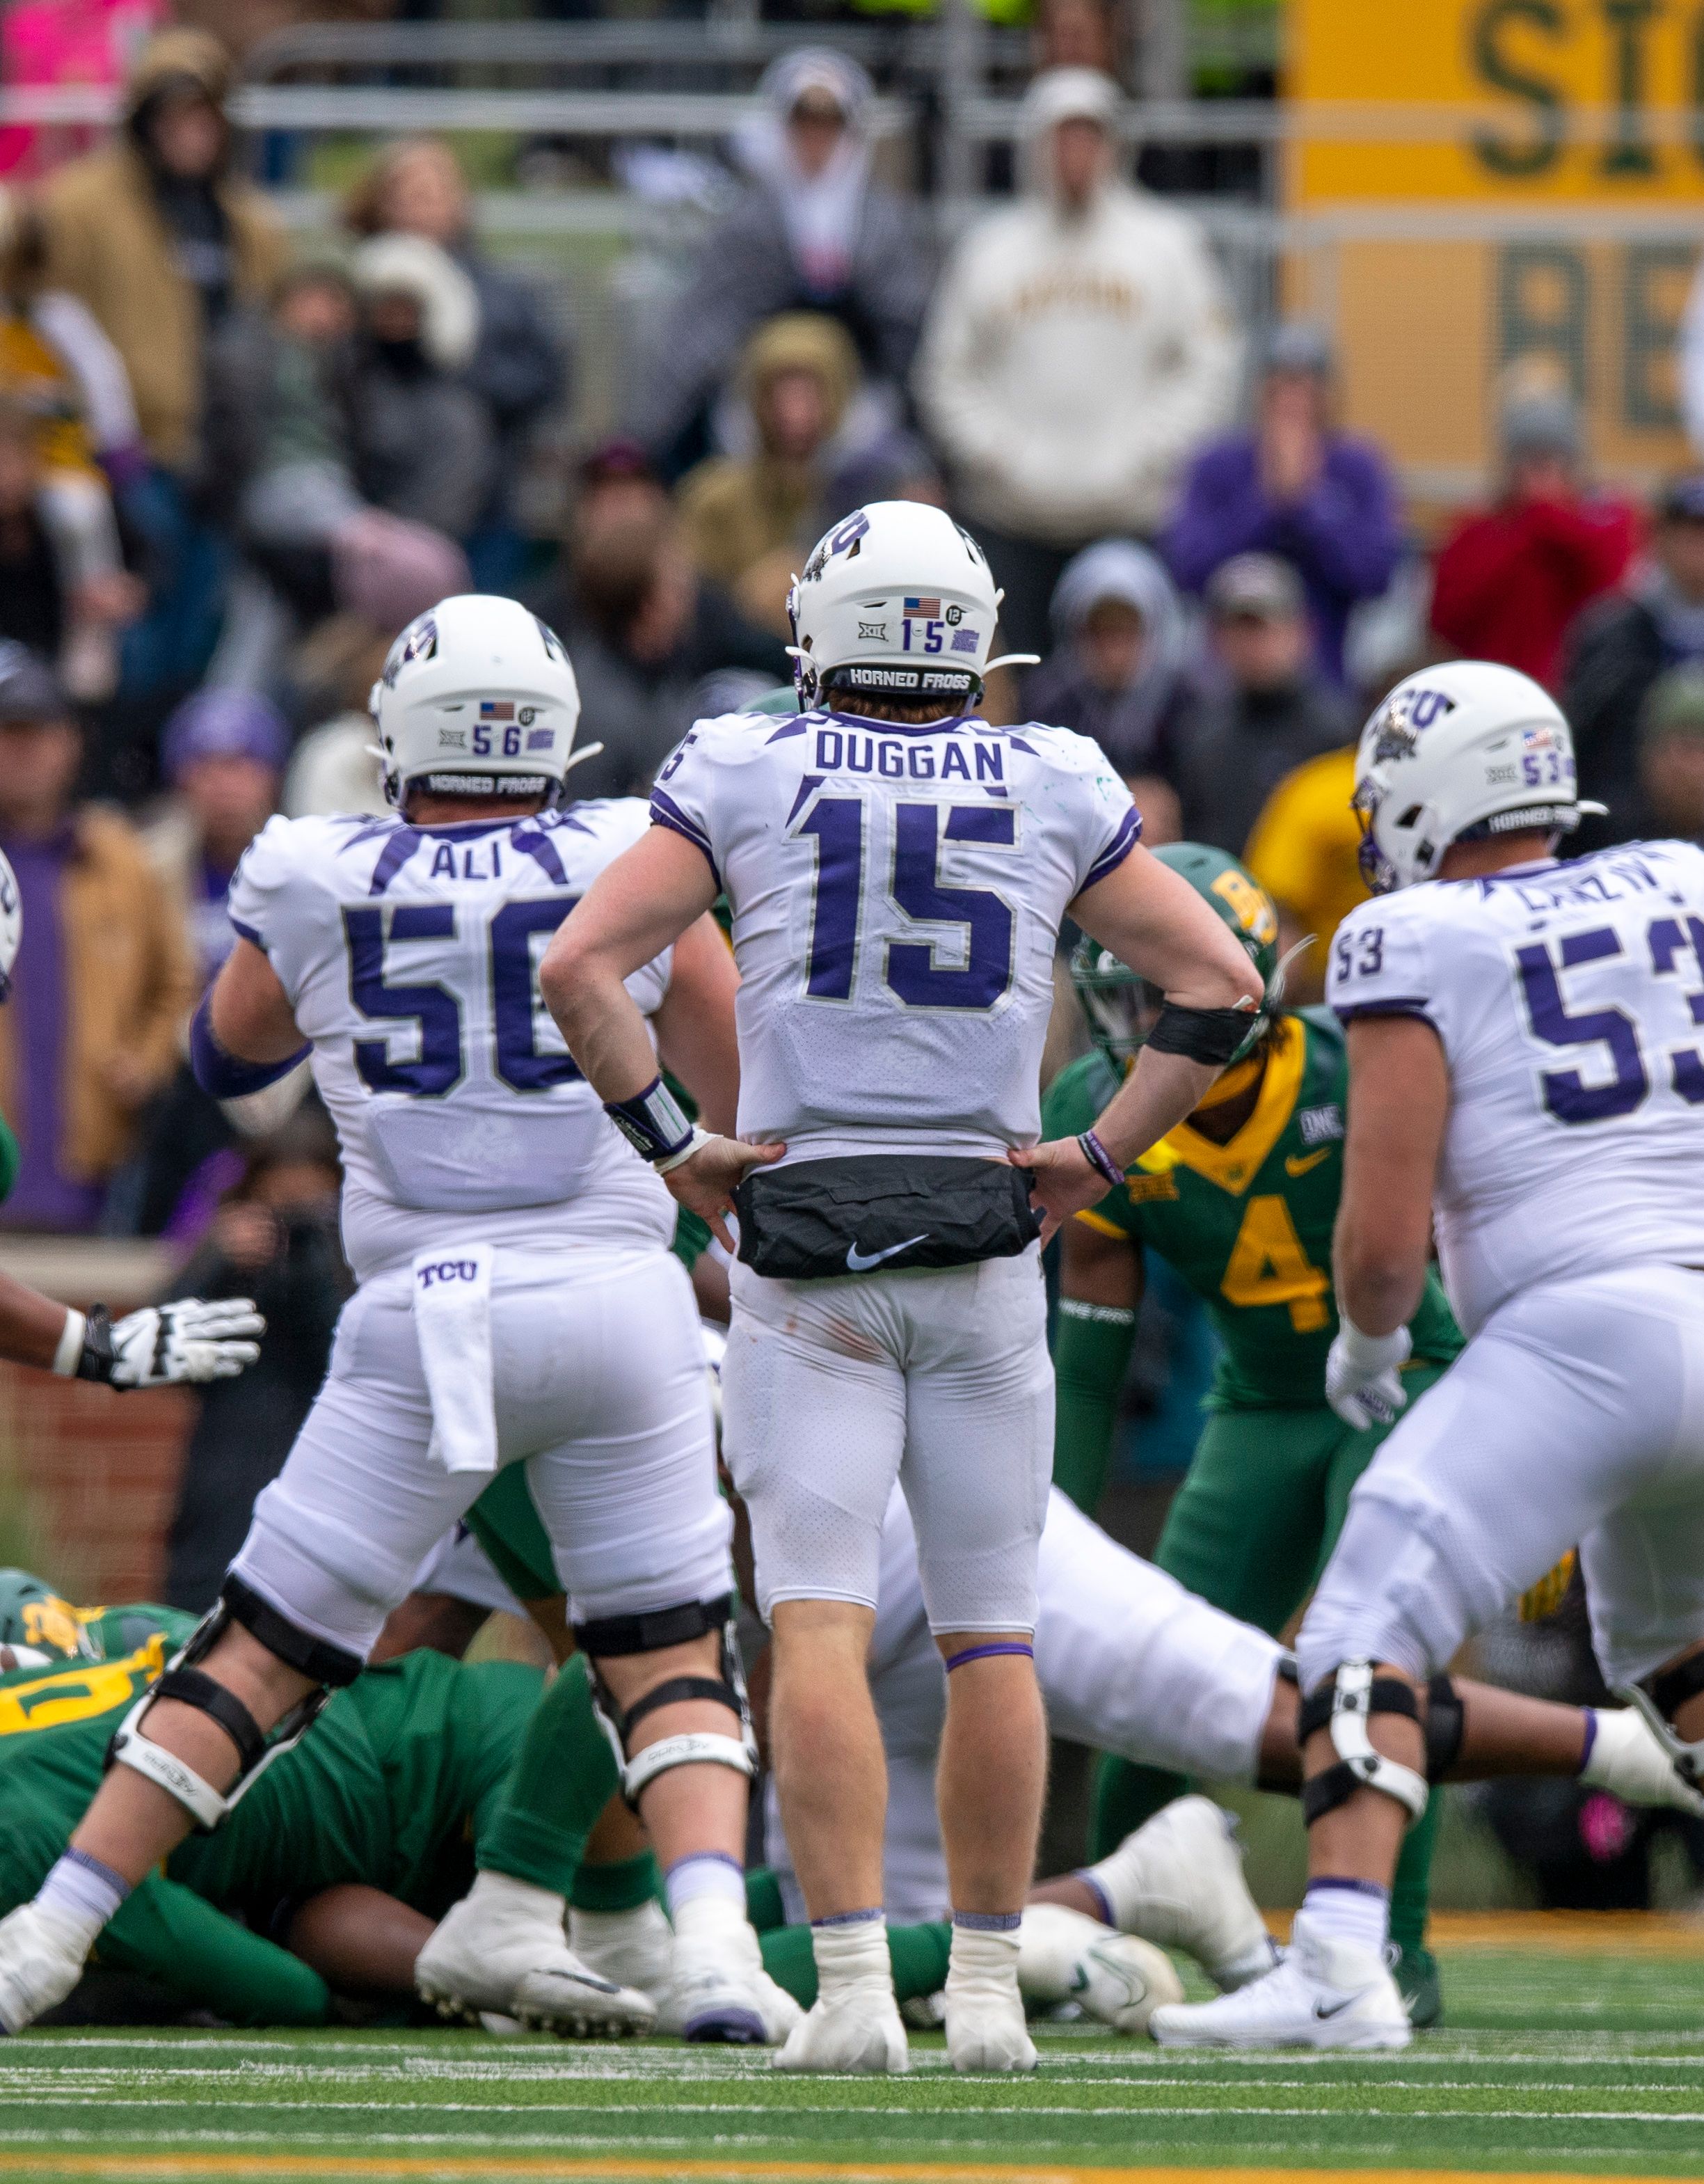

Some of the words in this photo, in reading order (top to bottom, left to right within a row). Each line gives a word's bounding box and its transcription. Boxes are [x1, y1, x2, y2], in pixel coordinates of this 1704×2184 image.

[1470, 0, 1704, 178] SI
[850, 668, 918, 688] HORNED
[921, 672, 972, 690] FROGS
[472, 725, 521, 757] 56
[815, 729, 1004, 781] DUGGAN
[430, 840, 502, 880] ALI
[786, 792, 1020, 1015] 15
[1337, 926, 1383, 981] 53
[417, 1260, 478, 1290] TCU
[1220, 1192, 1330, 1334] 4
